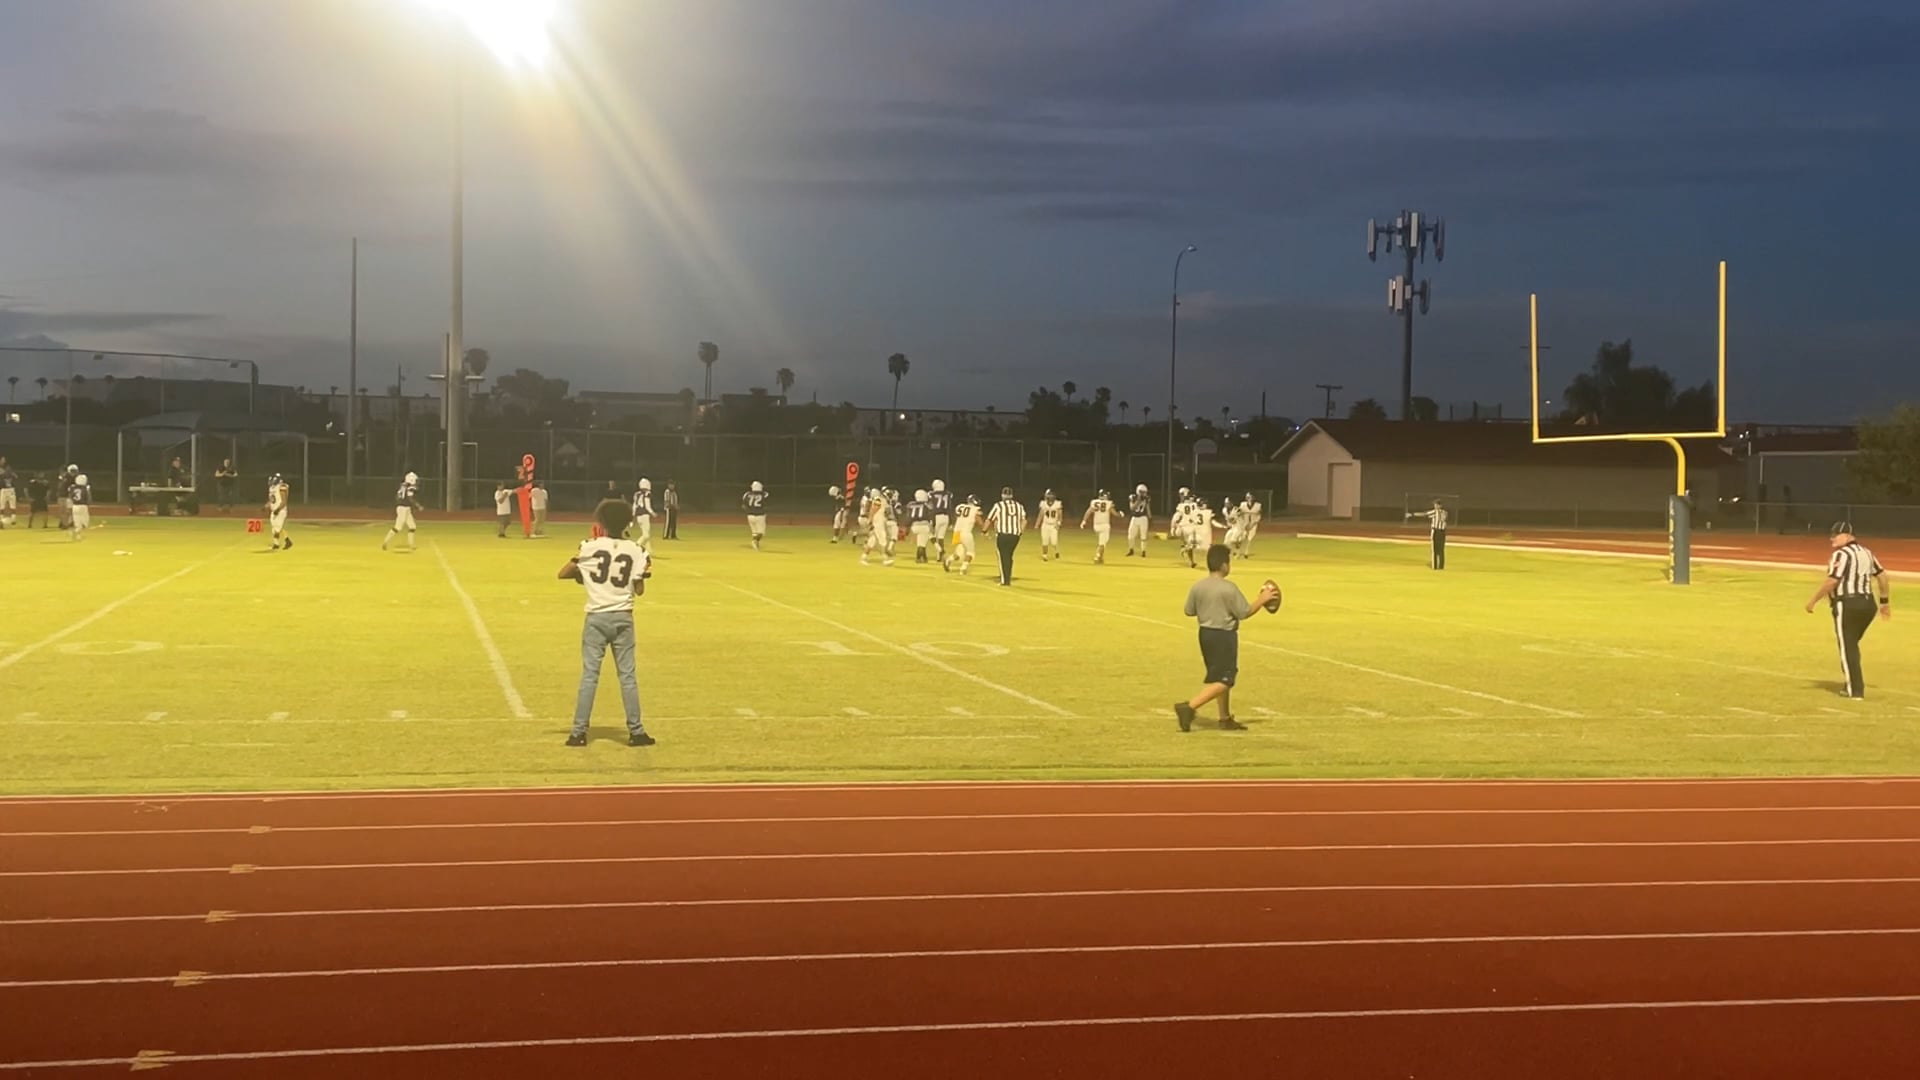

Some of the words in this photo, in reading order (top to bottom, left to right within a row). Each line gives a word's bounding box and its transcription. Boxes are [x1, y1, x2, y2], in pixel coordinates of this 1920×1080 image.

[74, 488, 83, 501] 3
[747, 494, 763, 508] 72
[934, 494, 949, 509] 71
[910, 504, 924, 518] 77
[956, 505, 971, 518] 50
[1196, 513, 1204, 526] 3
[248, 520, 261, 533] 20
[590, 549, 634, 588] 33
